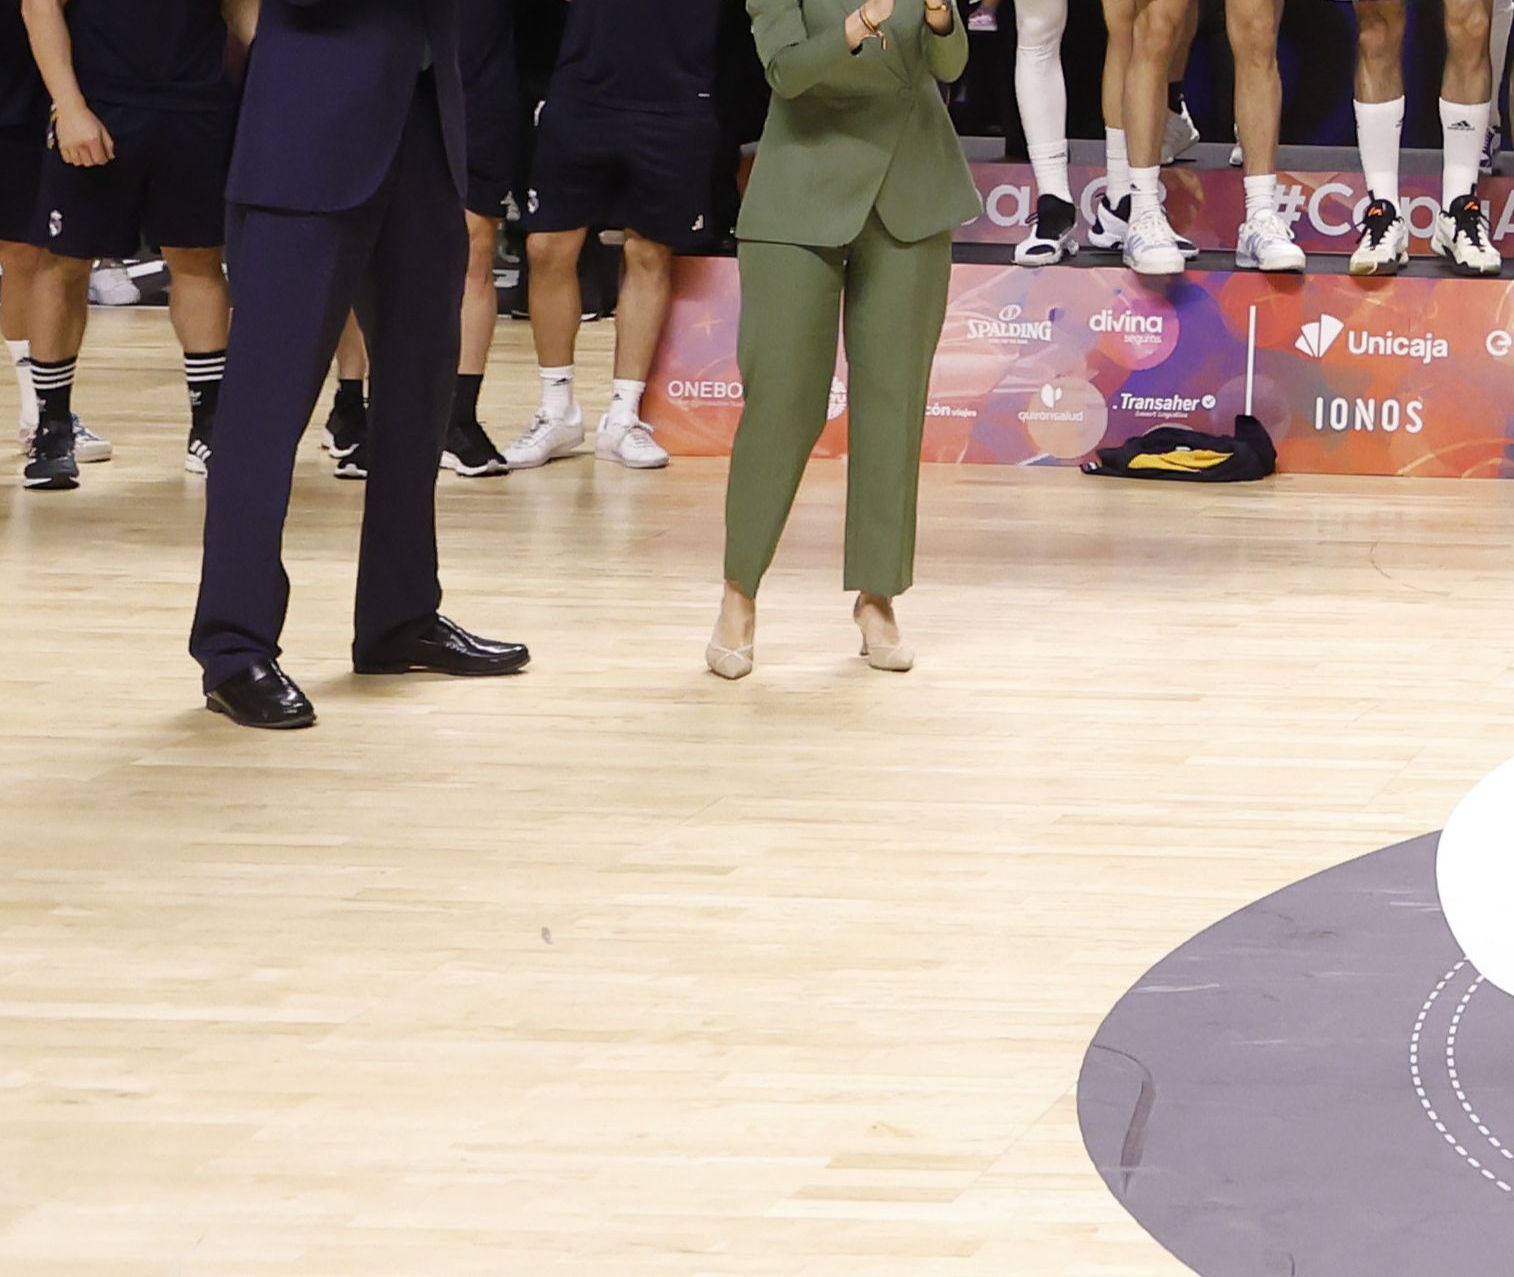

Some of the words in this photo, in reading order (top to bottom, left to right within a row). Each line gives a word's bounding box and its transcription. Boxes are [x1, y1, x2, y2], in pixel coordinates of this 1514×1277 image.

[967, 320, 1052, 341] SPALDING
[1089, 310, 1163, 333] divina
[1348, 331, 1448, 364] Unicaja
[668, 380, 745, 399] ONEBO
[1120, 392, 1200, 412] Transaher
[1314, 396, 1424, 434] IONOS
